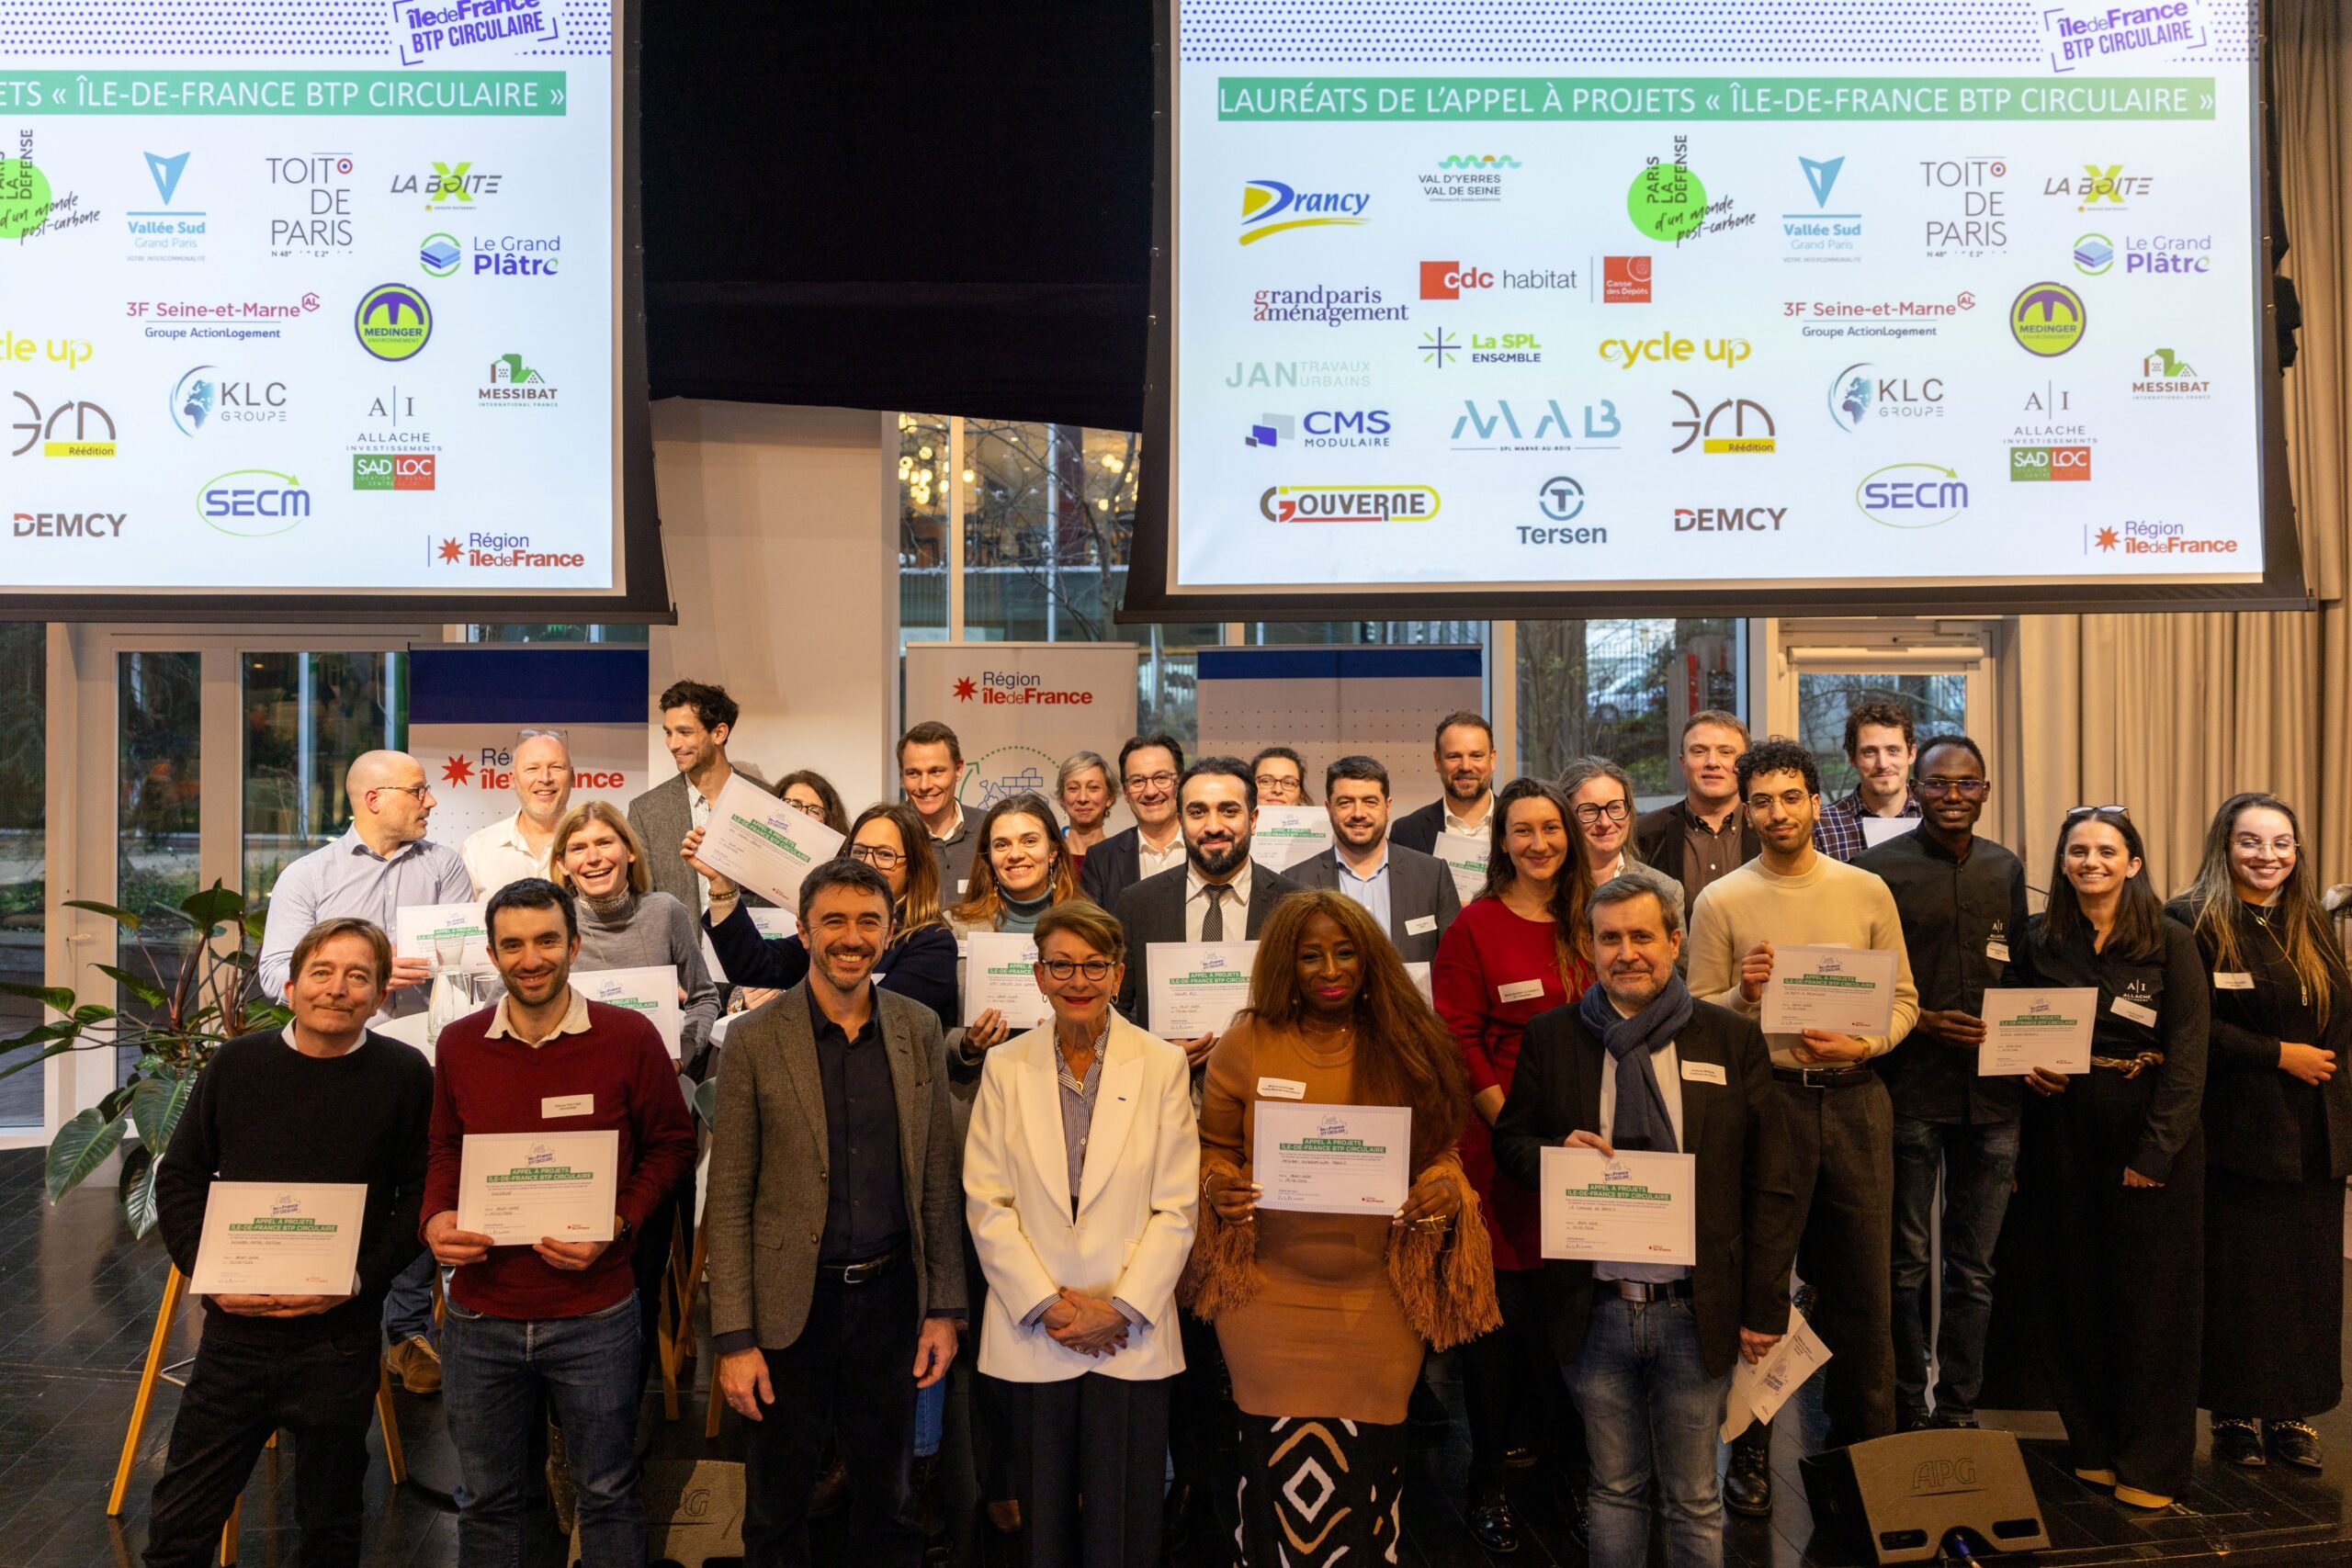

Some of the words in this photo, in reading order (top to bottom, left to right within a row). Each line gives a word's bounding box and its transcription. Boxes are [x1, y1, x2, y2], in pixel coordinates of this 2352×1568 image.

[2056, 2, 2188, 38] îledeFrance
[412, 28, 444, 53] BTP
[448, 11, 545, 47] CIRCULAIRE
[2063, 38, 2094, 61] BTP
[2098, 20, 2194, 55] CIRCULAIRE
[76, 74, 296, 107] ÎLE-DE-FRANCE
[307, 82, 358, 107] BTP
[369, 82, 538, 107] CIRCULAIRE
[1220, 82, 1368, 113] LAURÉATS
[1379, 88, 1416, 112] DE
[1543, 81, 1563, 112] À
[1573, 87, 1696, 113] PROJETS
[1729, 82, 1949, 112] ÎLE-DE-FRANCE
[1960, 88, 2011, 112] BTP
[2020, 88, 2188, 112] CIRCULAIRE
[20, 130, 33, 199] DEFENSE
[1675, 135, 1687, 203] DEFENSE
[6, 177, 18, 199] LA
[390, 175, 418, 194] LA
[1419, 175, 1441, 184] VAL
[2043, 177, 2071, 196] LA
[1423, 186, 1446, 196] VAL
[1449, 186, 1464, 196] DE
[1467, 186, 1501, 196] SEINE
[1661, 182, 1673, 203] LA
[35, 191, 79, 218] monde
[311, 188, 351, 215] DE
[1241, 180, 1370, 225] Drancy
[1690, 195, 1734, 221] monde
[1965, 191, 2005, 216] DE
[20, 209, 100, 246] post-carbone
[128, 221, 174, 234] Vallée
[178, 221, 206, 234] Sud
[272, 220, 353, 246] PARIS
[1677, 212, 1756, 248] post-carbone
[1784, 223, 1829, 236] Vallée
[1833, 223, 1861, 236] Sud
[1927, 220, 2007, 246] PARIS
[134, 237, 169, 248] Grand
[172, 237, 198, 248] Paris
[474, 235, 497, 252] Le
[502, 235, 560, 252] Grand
[1791, 239, 1825, 250] Grand
[1828, 239, 1853, 250] Paris
[2126, 235, 2148, 251] Le
[2153, 234, 2211, 251] Grand
[474, 253, 560, 276] Plâtre
[2127, 252, 2210, 274] Plâtre
[1444, 266, 1494, 289] cdc
[1503, 269, 1577, 289] habitat
[1606, 279, 1633, 288] Caisse
[1621, 287, 1648, 296] Dépôts
[127, 301, 151, 317] 3F
[156, 301, 301, 317] Seine-et-Marne
[1253, 304, 1409, 327] aménagement
[1783, 301, 1806, 317] 3F
[1814, 301, 1956, 317] Seine-et-Marne
[145, 327, 187, 341] Groupe
[190, 327, 281, 341] ActionLogement
[364, 328, 423, 337] MEDINGER
[1803, 326, 1844, 339] Groupe
[1847, 326, 1937, 339] ActionLogement
[2019, 324, 2076, 333] MEDINGER
[1472, 334, 1496, 349] La
[1501, 334, 1541, 349] SPL
[1599, 331, 1695, 369] cycle
[1704, 337, 1751, 368] up
[47, 339, 94, 370] up
[1226, 361, 1297, 388] JAN
[1299, 360, 1371, 372] TRAVAUX
[1299, 376, 1371, 388] URBAINS
[220, 381, 288, 407] KLC
[479, 389, 558, 400] MESSIBAT
[1879, 378, 1944, 402] KLC
[2132, 381, 2210, 392] MESSIBAT
[220, 411, 288, 423] GROUPE
[1451, 399, 1622, 439] MAB
[1879, 406, 1944, 417] GROUPE
[1303, 410, 1392, 435] CMS
[2014, 425, 2086, 435] ALLACHE
[357, 433, 431, 443] ALLACHE
[1305, 437, 1390, 448] MODULAIRE
[69, 446, 114, 456] Réédition
[1728, 443, 1774, 453] Réédition
[356, 458, 392, 476] SAD
[396, 458, 432, 476] LOC
[2014, 451, 2049, 468] SAD
[2052, 451, 2087, 467] LOC
[206, 490, 311, 516] SECM
[1260, 486, 1426, 523] GOUVERNE
[1865, 482, 1969, 509] SECM
[14, 513, 128, 537] DEMCY
[1674, 507, 1788, 532] DEMCY
[1516, 525, 1608, 545] Tersen
[2125, 521, 2184, 539] Région
[469, 532, 529, 551] Région
[2124, 536, 2238, 555] îledeFrance
[469, 549, 585, 568] îledeFrance
[983, 671, 1040, 690] Région
[982, 687, 1093, 705] îledeFrance
[1913, 1457, 1976, 1490] APG
